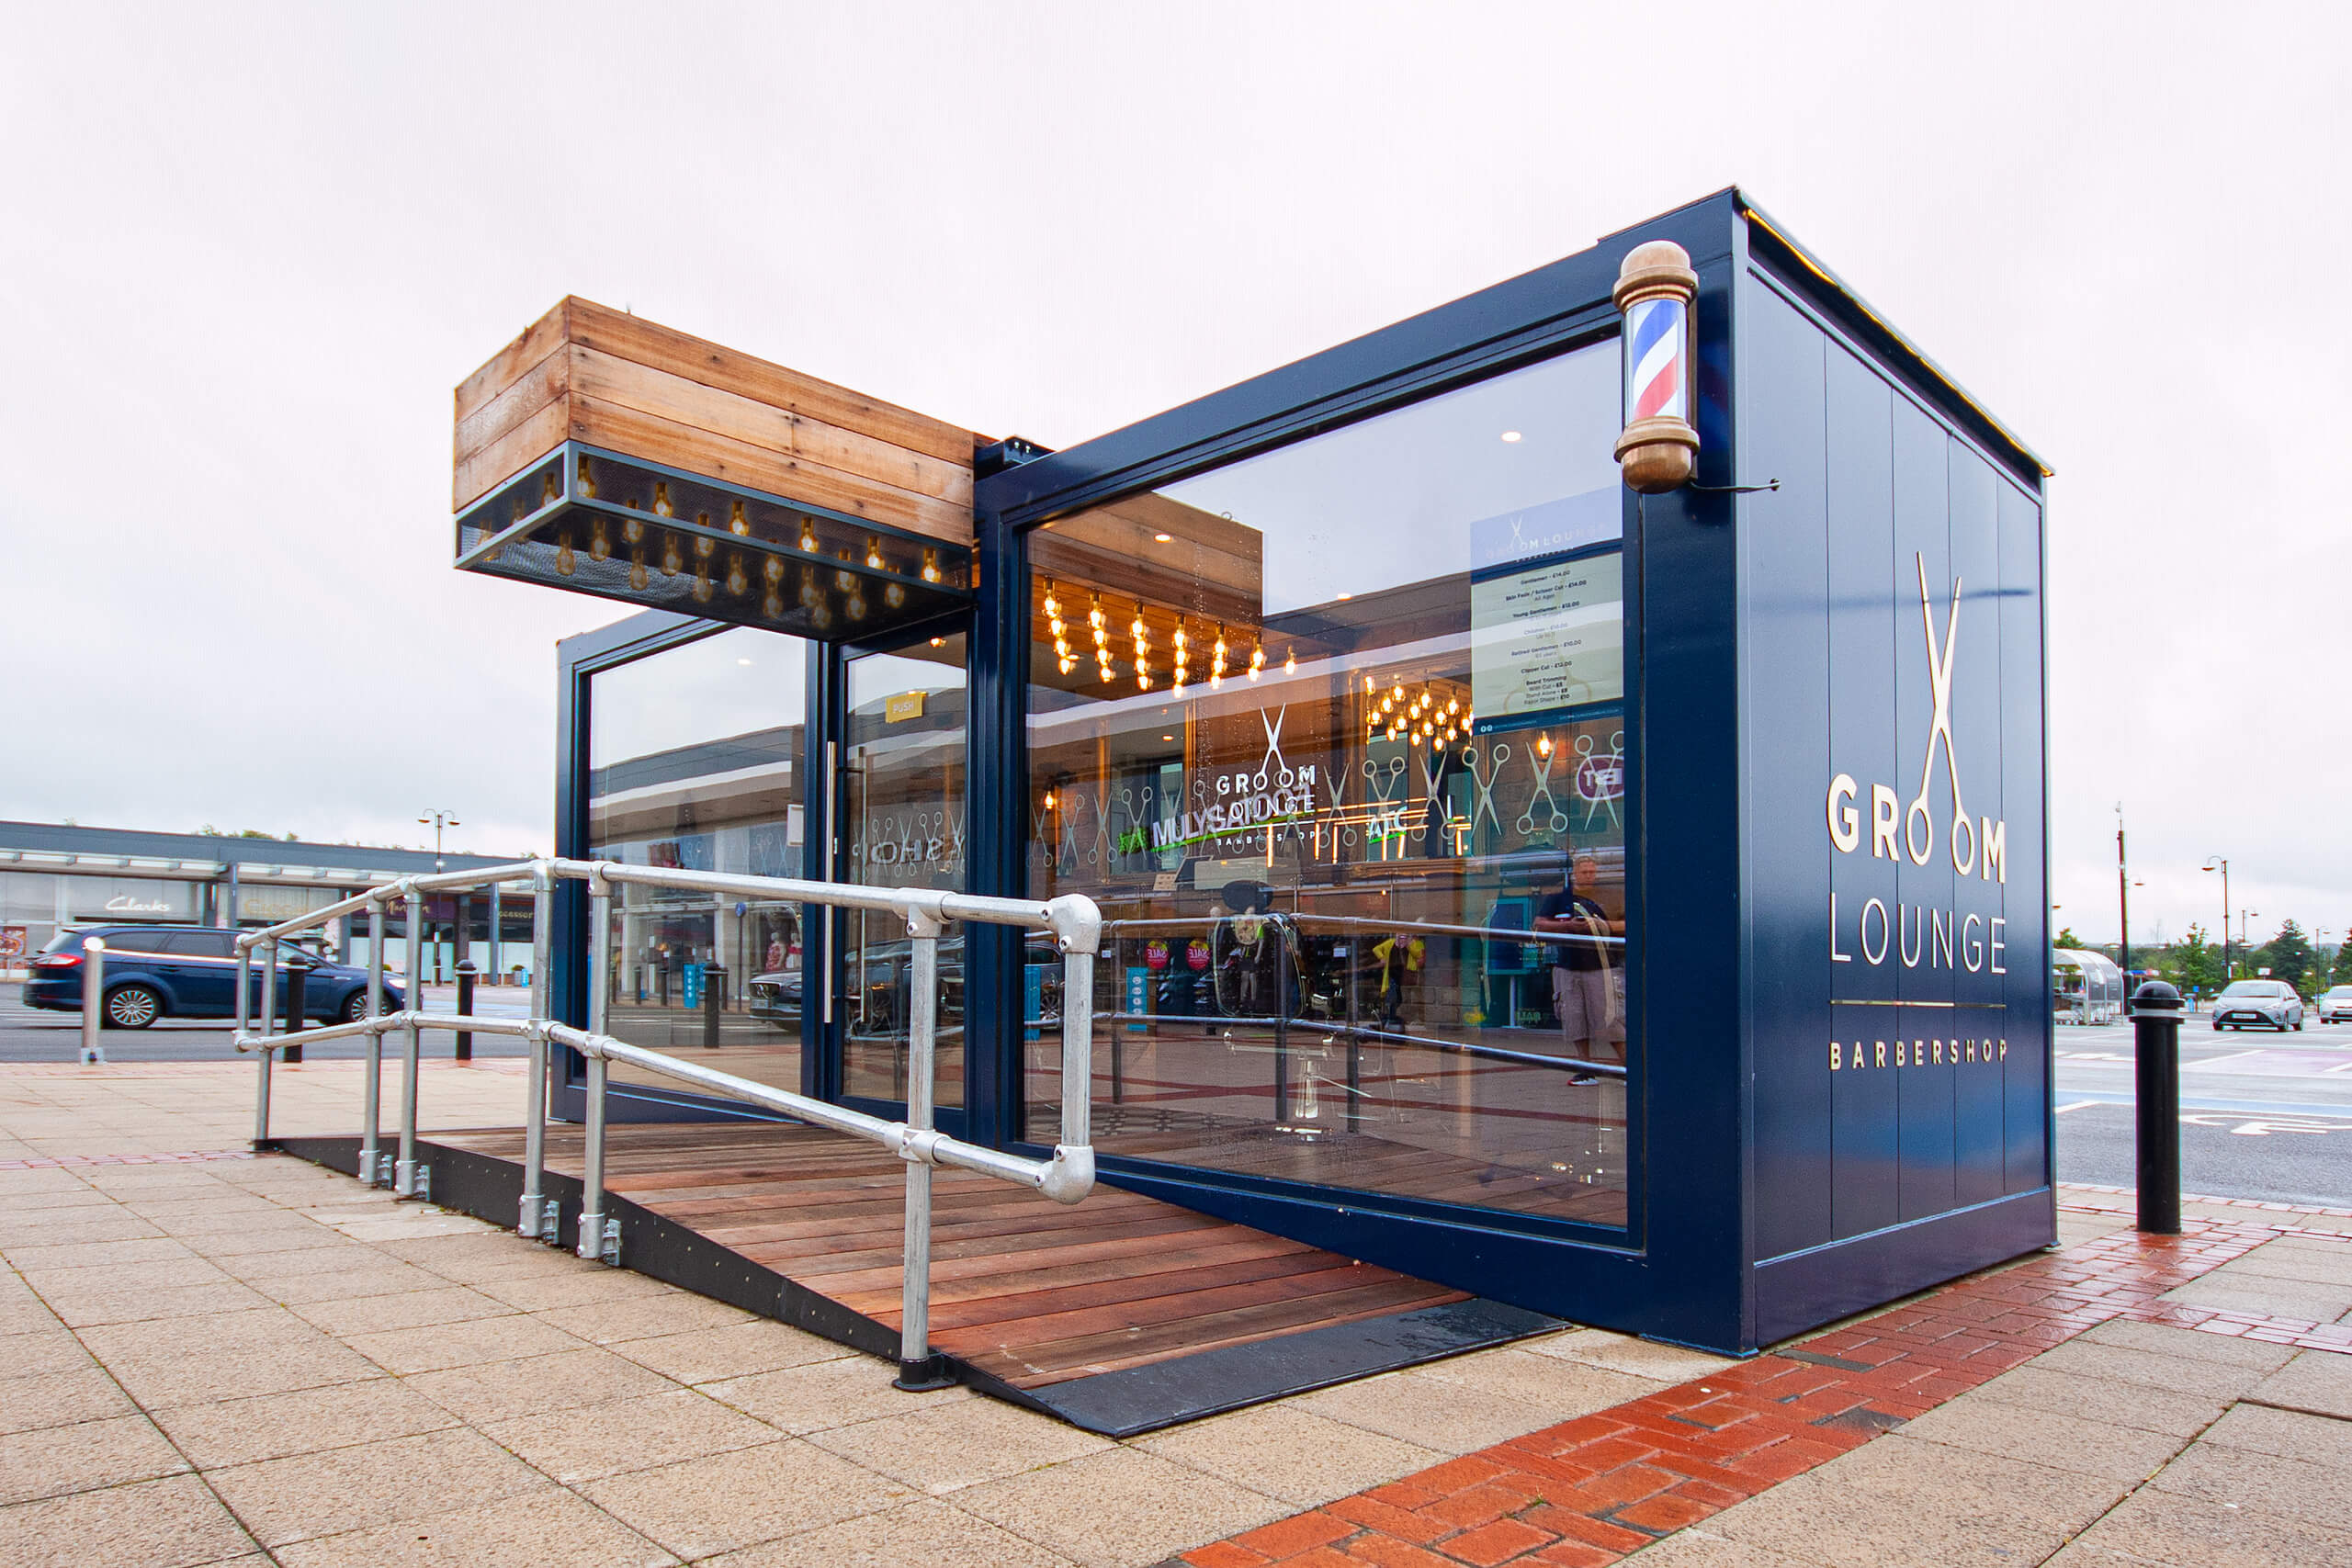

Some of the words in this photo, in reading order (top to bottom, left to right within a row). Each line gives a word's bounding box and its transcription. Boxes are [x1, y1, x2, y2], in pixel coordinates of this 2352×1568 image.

[892, 703, 914, 714] PUSH
[1216, 765, 1317, 795] GROOM
[1216, 794, 1316, 821] LOUNGE
[1827, 773, 2007, 884] GROOM
[105, 896, 171, 912] Clarks
[1829, 891, 2007, 975] LOUNGE
[1829, 1039, 2007, 1071] BARBERSHOP
